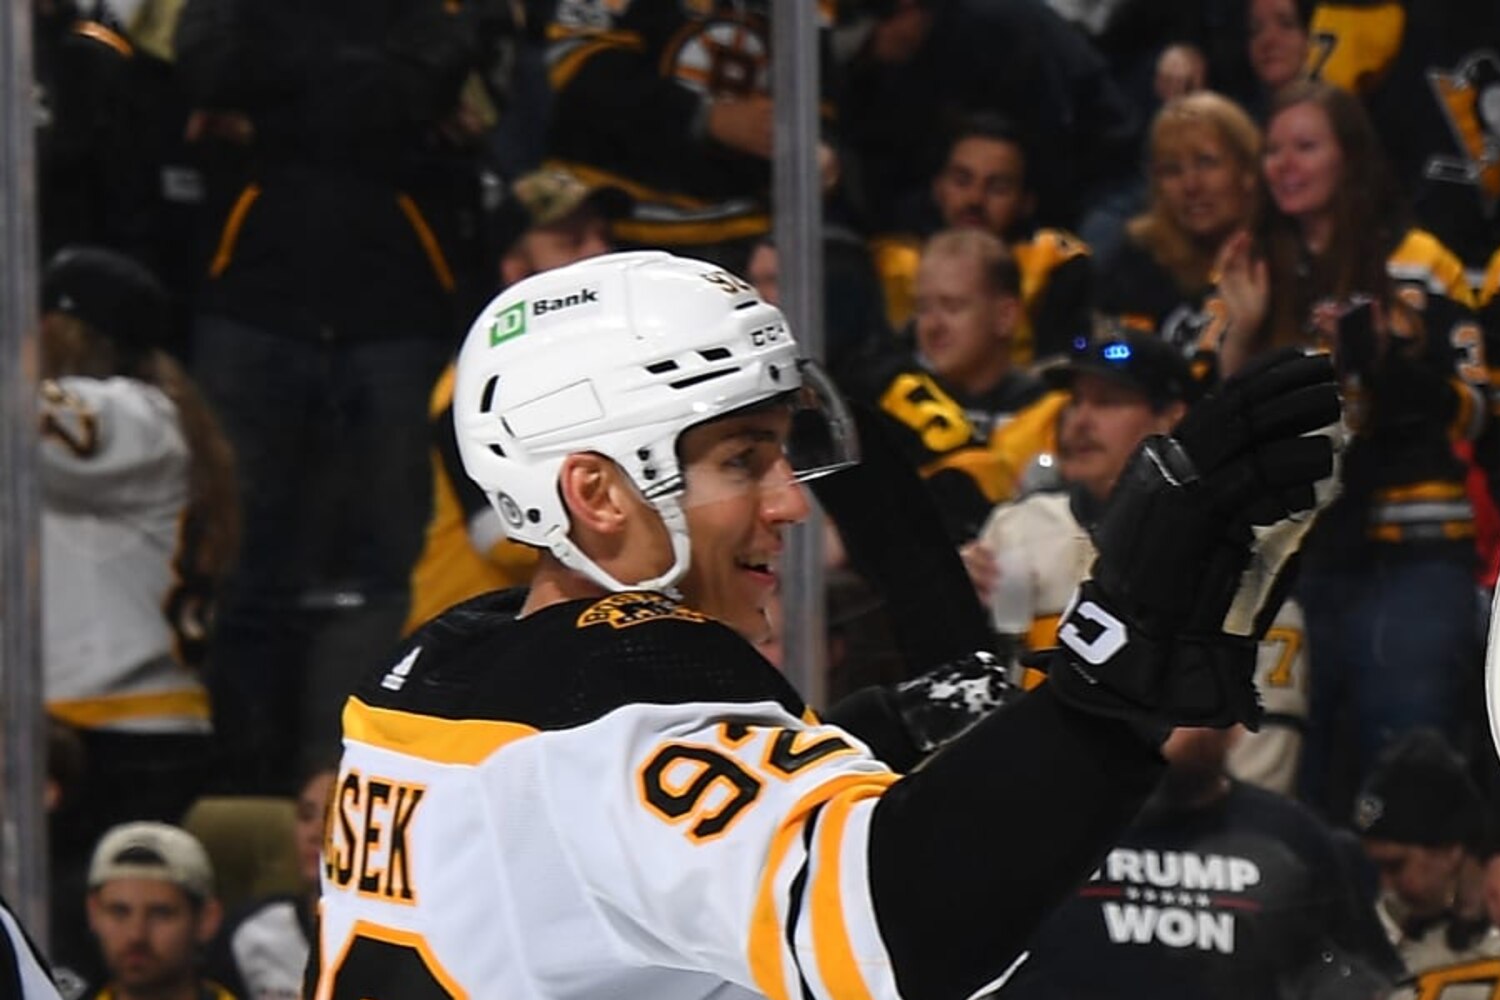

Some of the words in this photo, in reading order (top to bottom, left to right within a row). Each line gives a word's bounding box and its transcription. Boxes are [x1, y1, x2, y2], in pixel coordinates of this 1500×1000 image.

[532, 289, 598, 316] Bank
[323, 766, 427, 907] SEK
[1089, 848, 1261, 892] RUMP
[1102, 902, 1236, 954] WON
